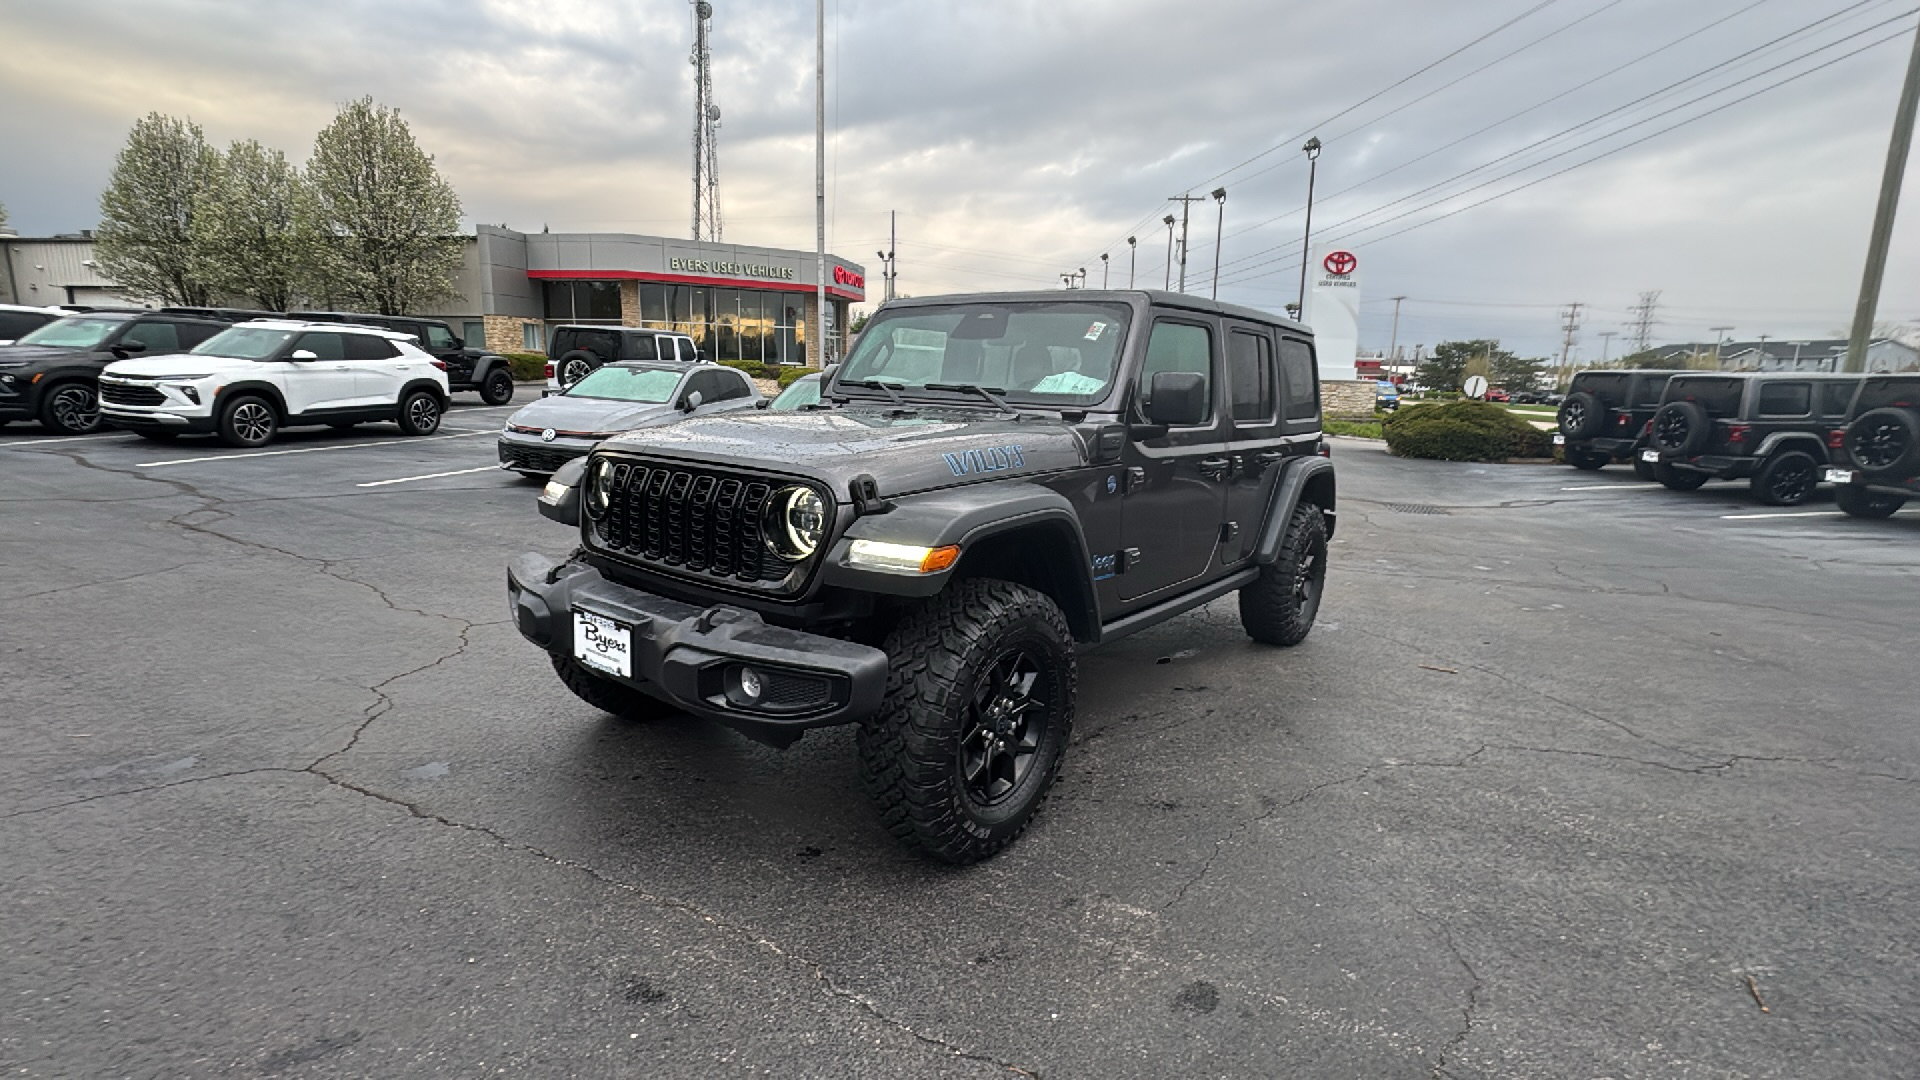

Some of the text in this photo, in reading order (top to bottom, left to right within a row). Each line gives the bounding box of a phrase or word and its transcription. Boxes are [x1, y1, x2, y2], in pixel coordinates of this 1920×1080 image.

[671, 257, 794, 279] BYERS USED VEHICLES
[844, 270, 864, 288] TOYOTA
[942, 445, 1025, 476] WILLYS
[580, 621, 626, 653] Byers
